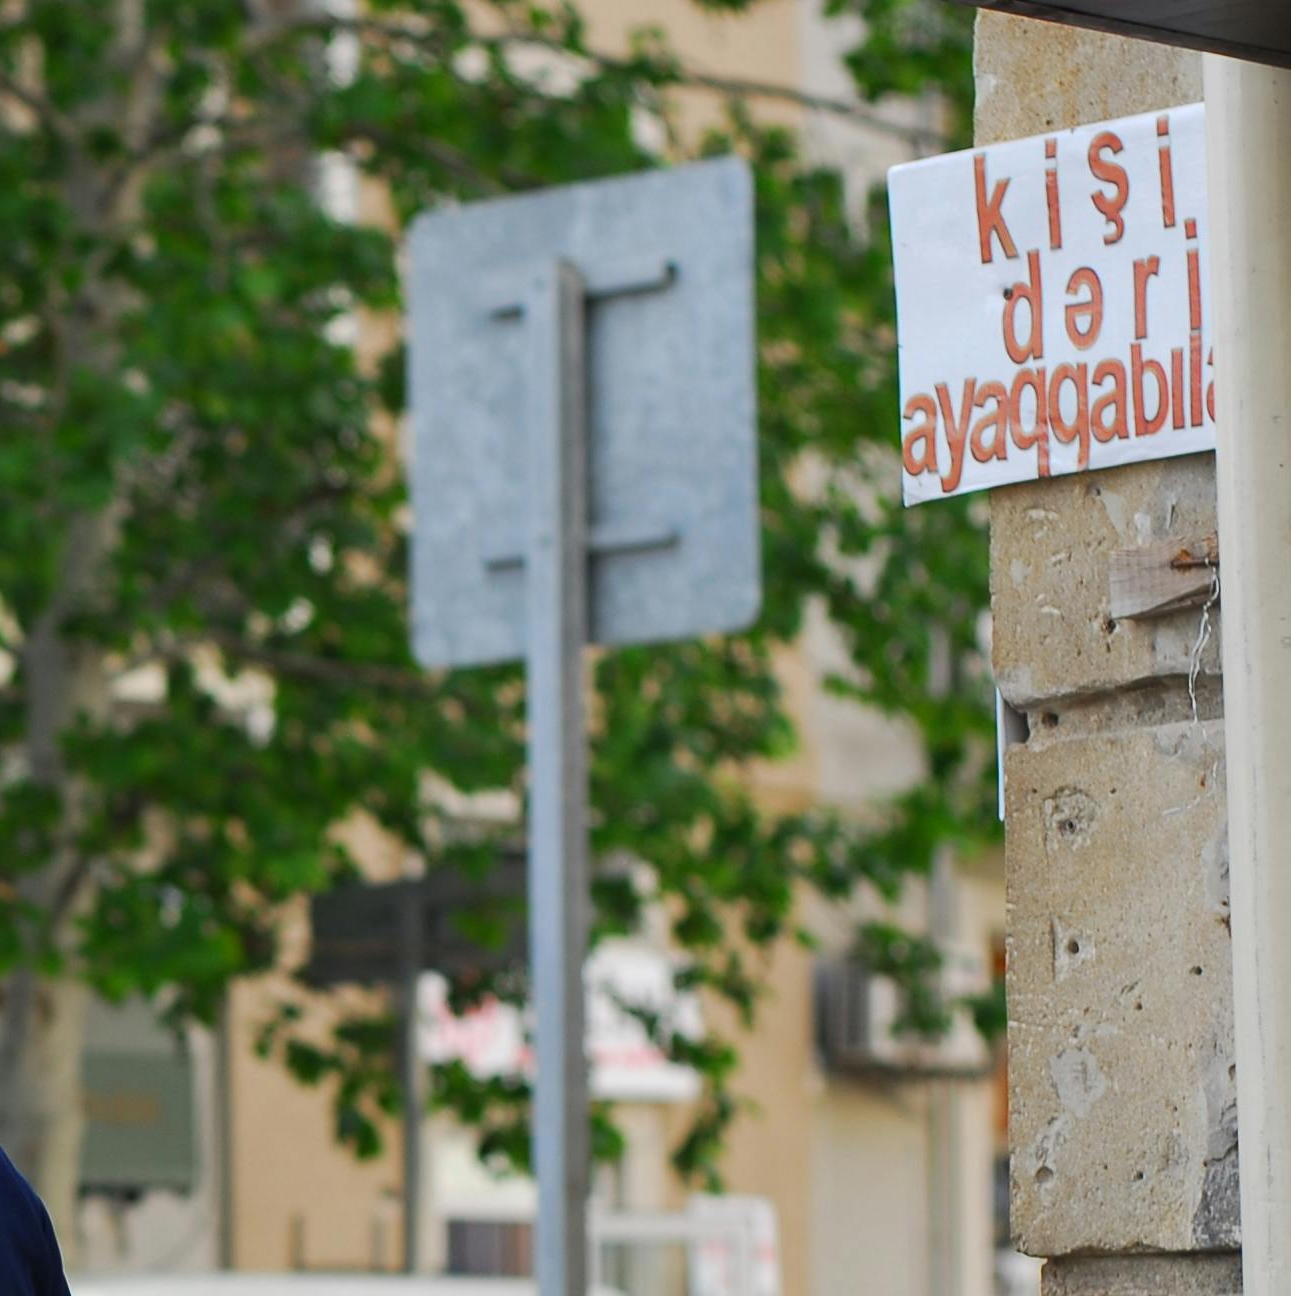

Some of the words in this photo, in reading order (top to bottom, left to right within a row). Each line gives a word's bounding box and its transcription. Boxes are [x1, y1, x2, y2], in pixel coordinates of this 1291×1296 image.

[973, 115, 1176, 264] kişi
[1002, 218, 1203, 364] dəri
[902, 334, 1216, 493] ayaqqabıl
